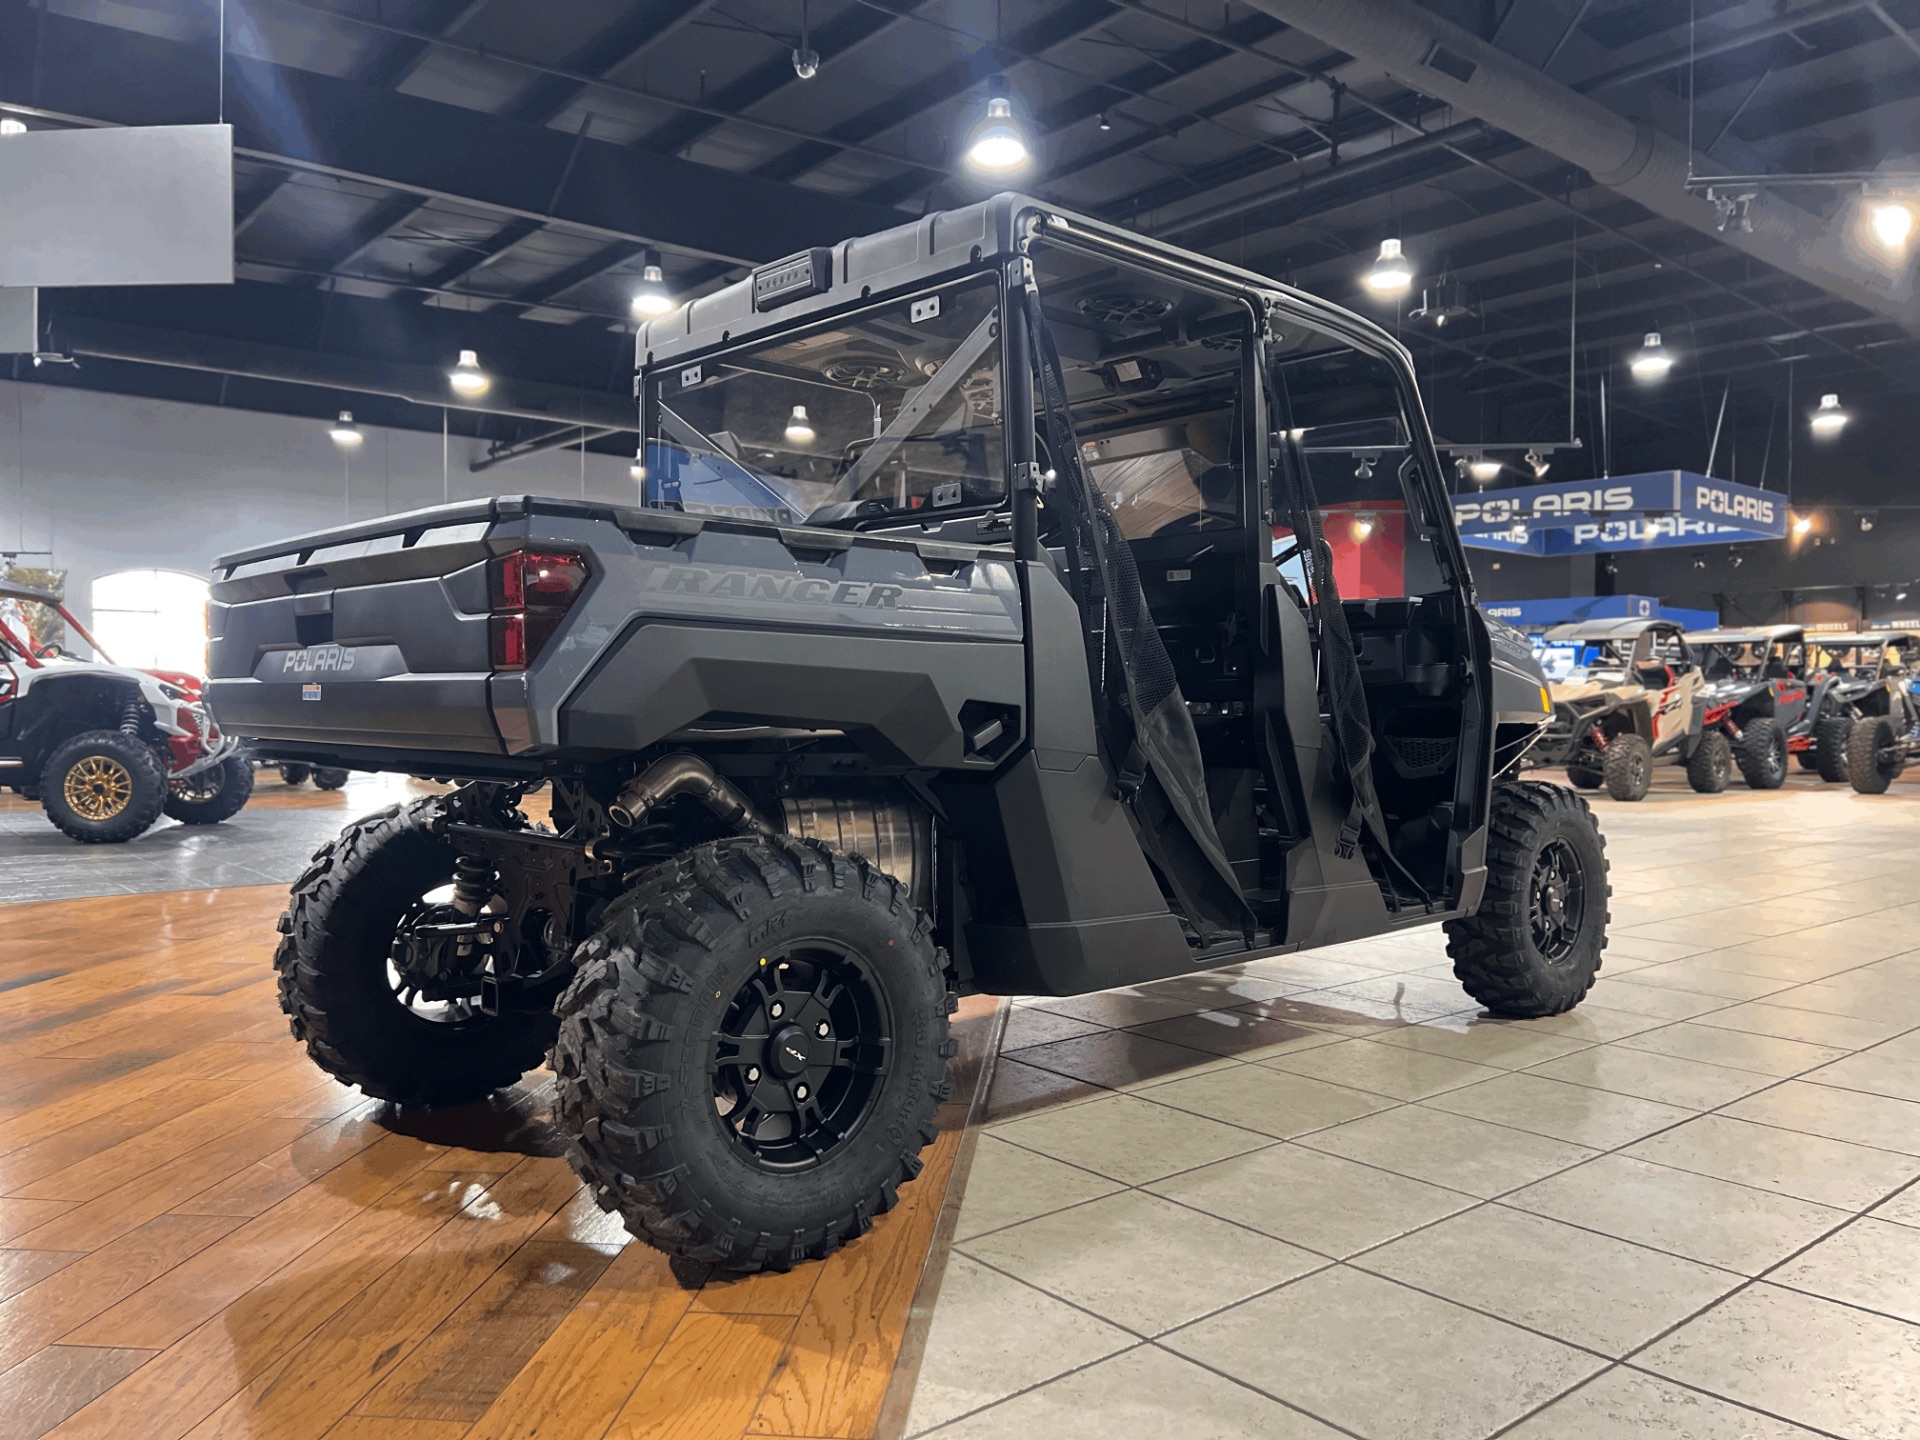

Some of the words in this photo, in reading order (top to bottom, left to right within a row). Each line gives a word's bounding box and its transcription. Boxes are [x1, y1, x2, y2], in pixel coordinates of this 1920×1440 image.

[1455, 486, 1634, 526] POLARIS
[1696, 486, 1774, 524] POLARIS
[659, 565, 905, 609] RANGER
[282, 647, 357, 673] POLARIS
